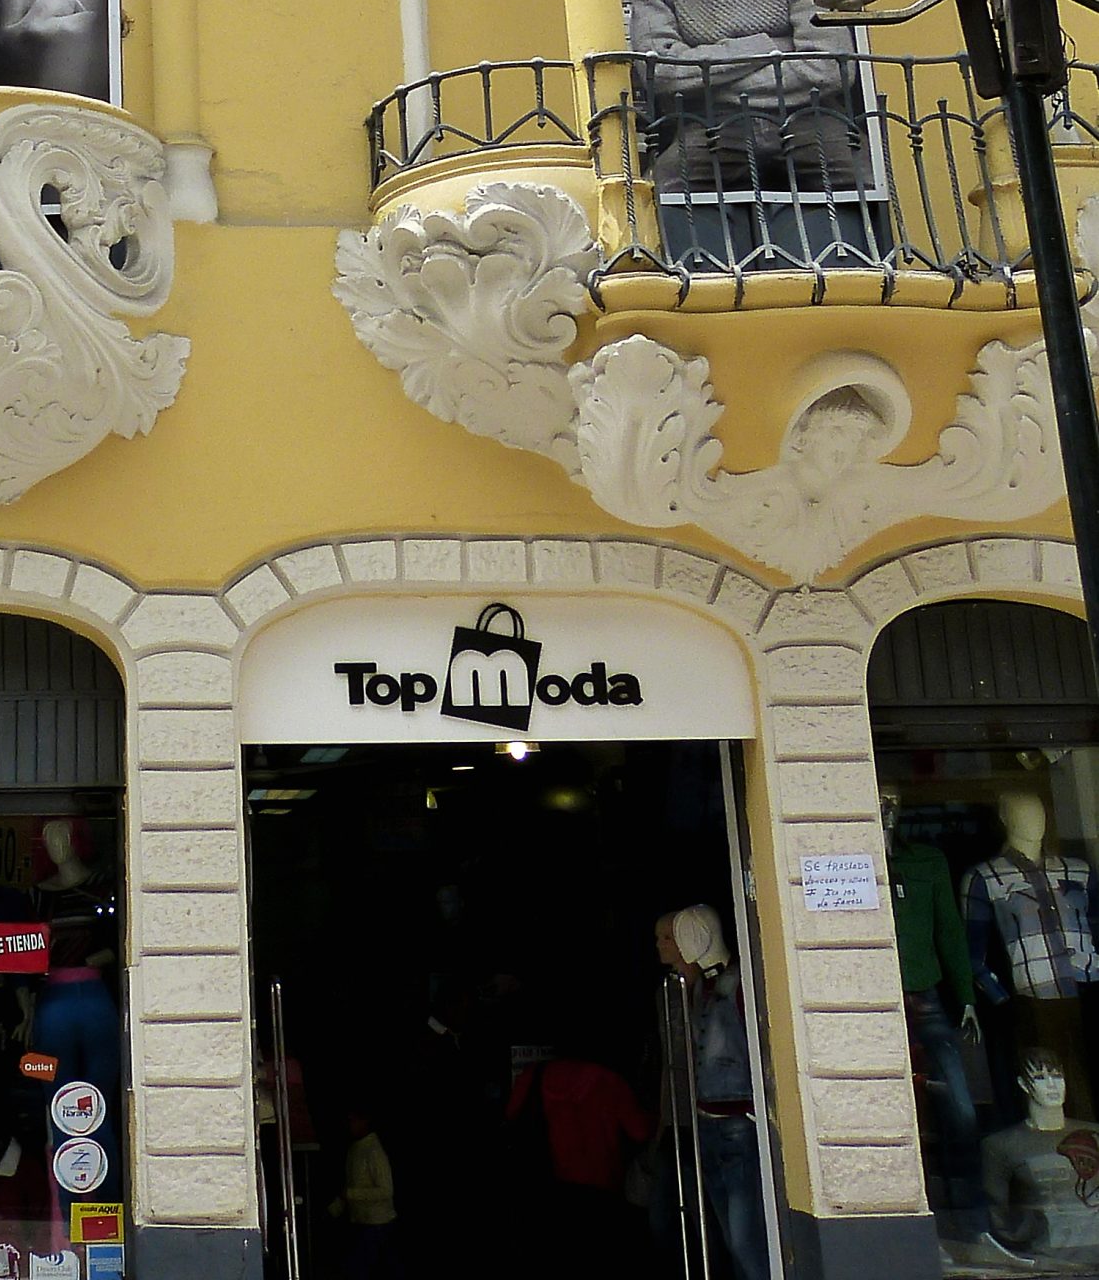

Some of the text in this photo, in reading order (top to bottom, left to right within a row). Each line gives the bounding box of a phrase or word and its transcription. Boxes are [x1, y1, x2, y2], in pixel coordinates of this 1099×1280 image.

[334, 661, 438, 712] Top
[5, 932, 46, 953] TIENDA
[24, 1063, 53, 1071] Outlet
